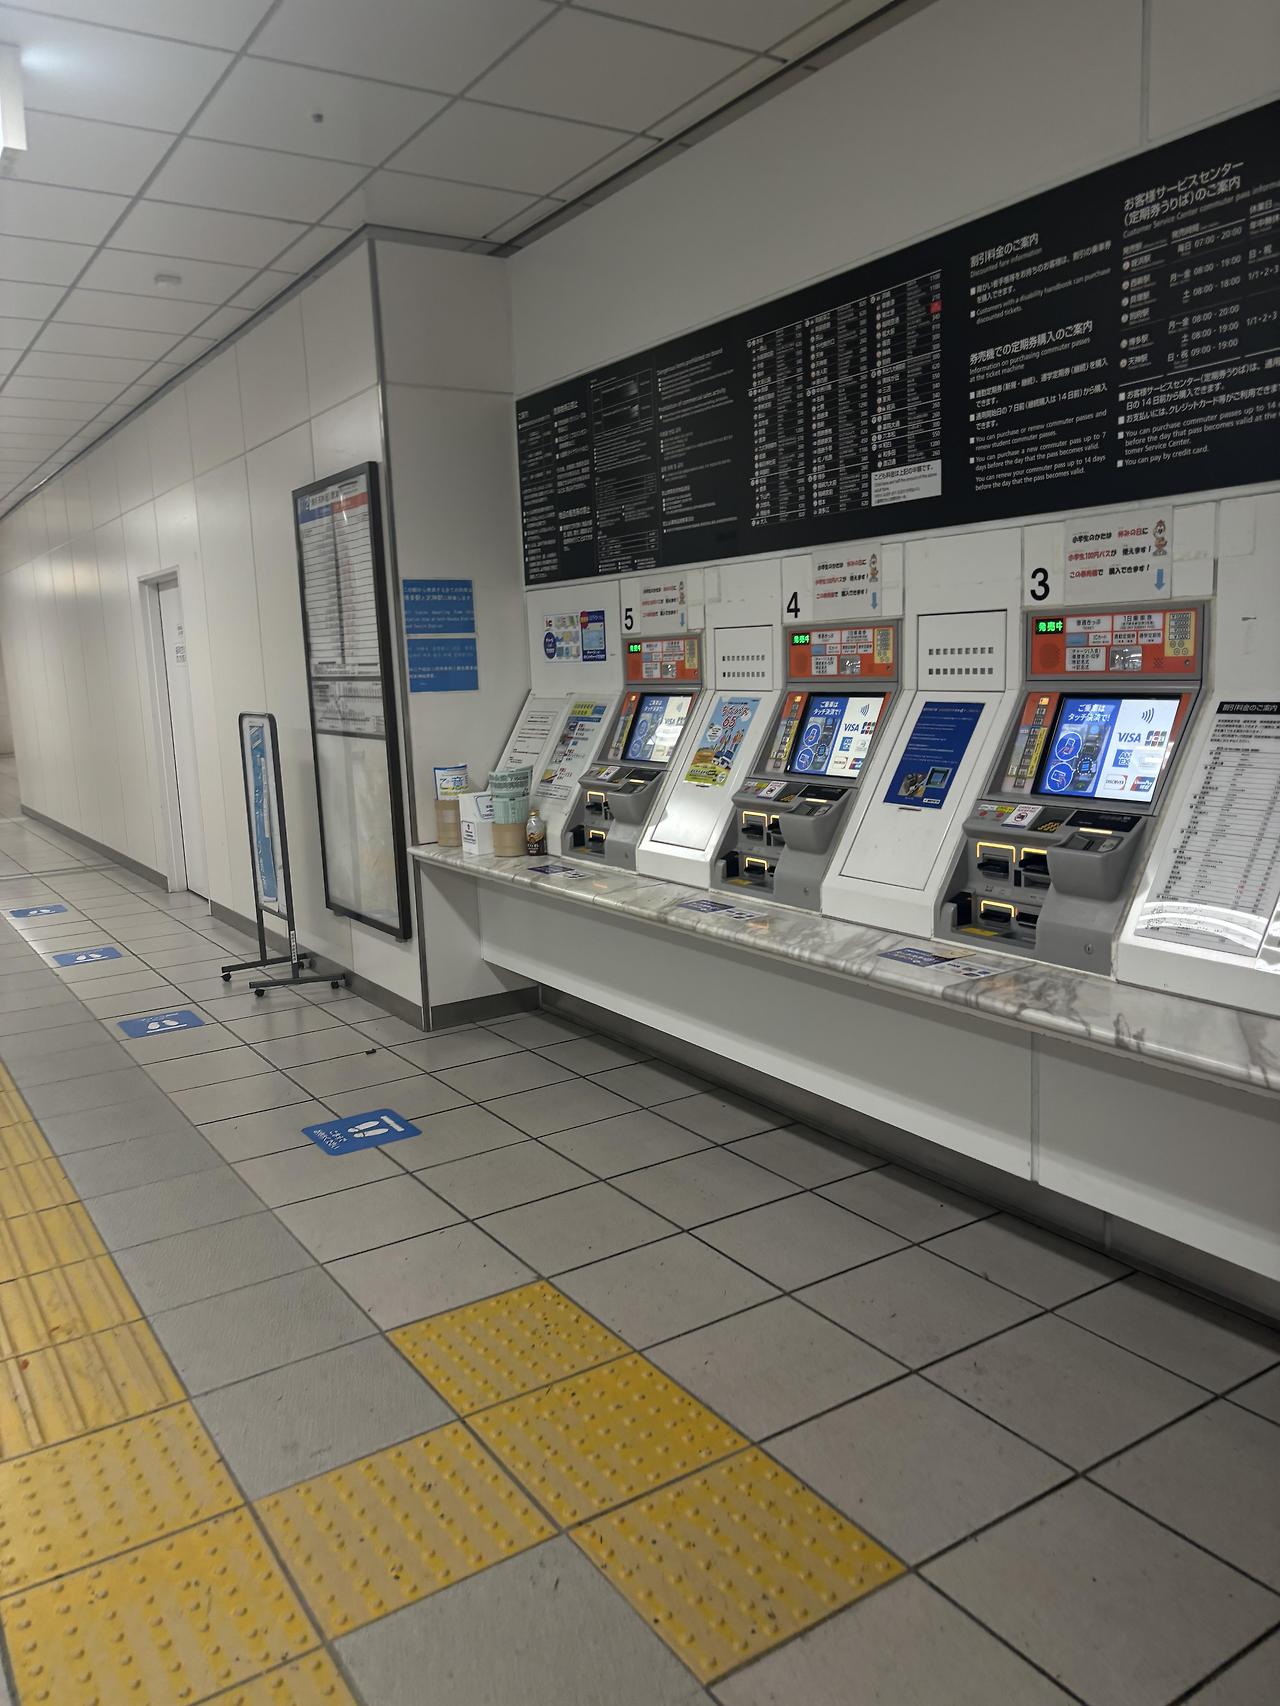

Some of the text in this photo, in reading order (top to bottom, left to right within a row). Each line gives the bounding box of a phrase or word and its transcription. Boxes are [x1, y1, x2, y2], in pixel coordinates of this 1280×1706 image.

[1124, 162, 1244, 211] お客様サービスセンター
[970, 233, 1039, 268] 割引料金のご案内
[969, 320, 1093, 366] 券売機での定期券購入のご案内
[1030, 566, 1050, 601] 3
[624, 608, 634, 630] 5
[786, 592, 800, 618] 4
[844, 723, 860, 732] VISA
[1118, 732, 1141, 743] VISA
